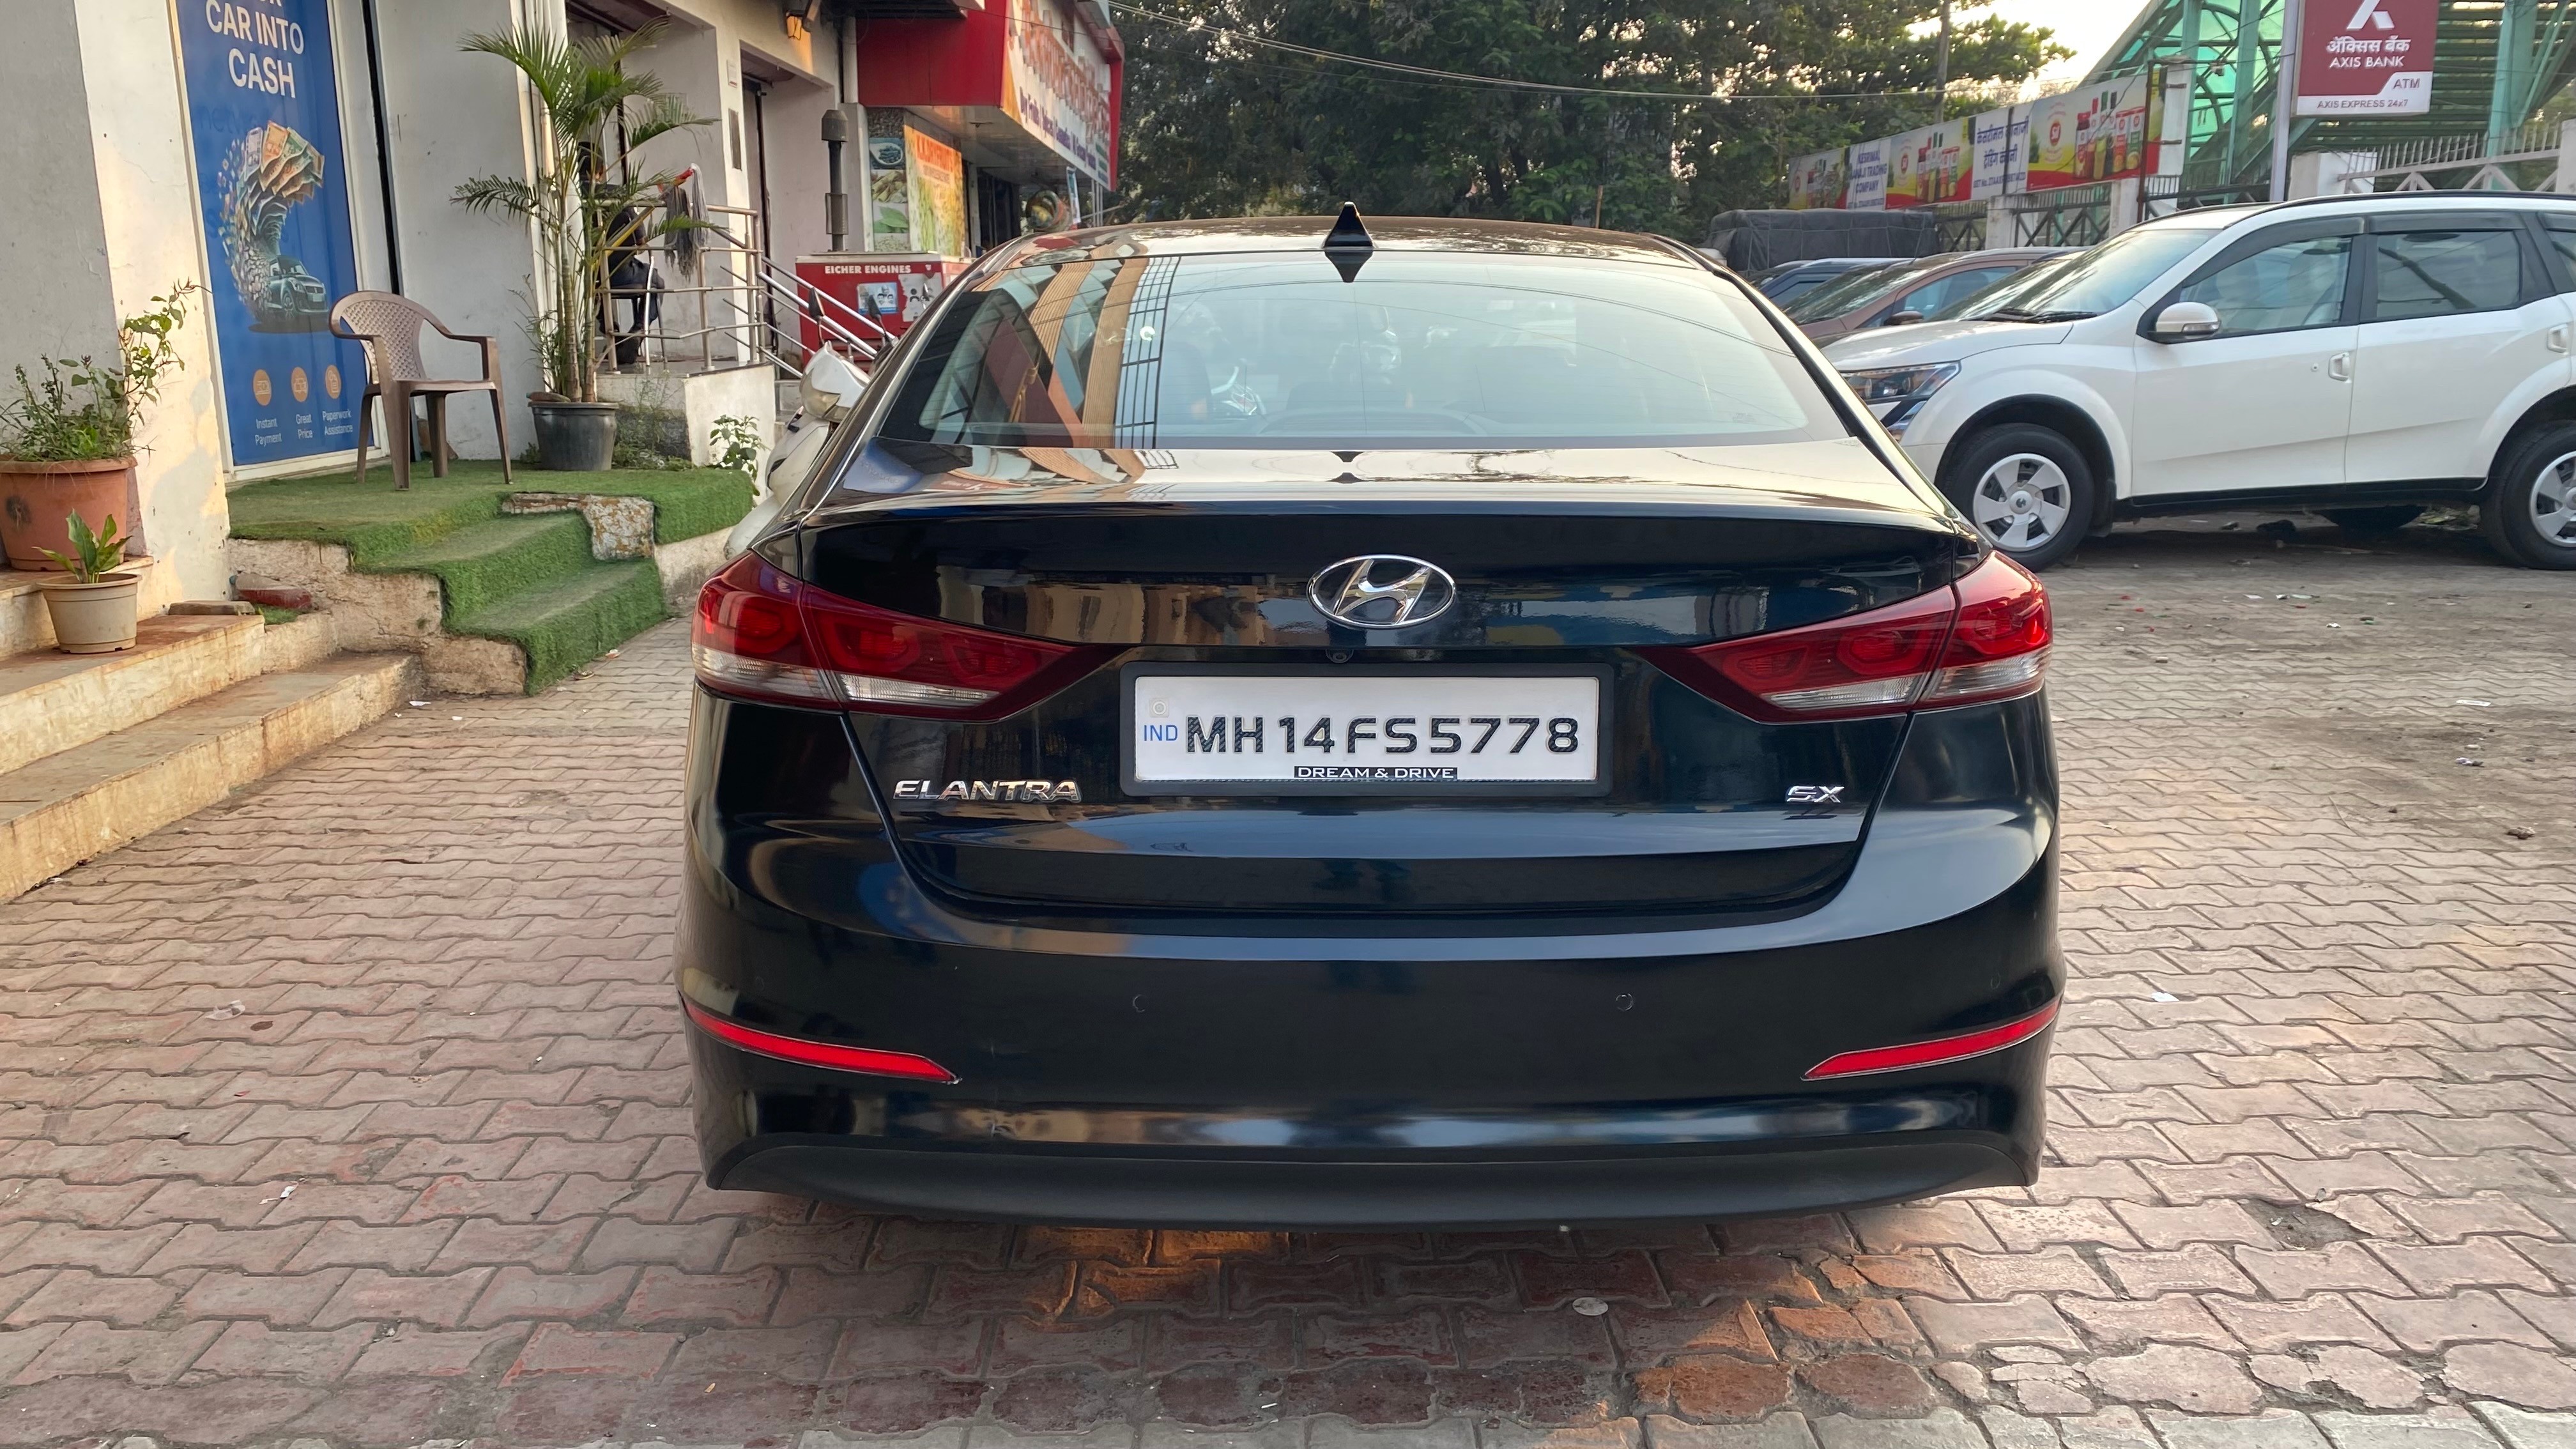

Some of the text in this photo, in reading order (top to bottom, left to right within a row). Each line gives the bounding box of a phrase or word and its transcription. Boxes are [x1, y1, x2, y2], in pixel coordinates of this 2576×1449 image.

[206, 0, 304, 54] CAR INTO
[2329, 56, 2405, 68] AXIS BANK
[229, 48, 296, 98] CASH
[2393, 79, 2420, 89] ATM
[2317, 99, 2408, 109] AXIS EXPRESS 24x7
[825, 264, 912, 274] EICHER ENGINES
[295, 414, 312, 424] Great
[322, 409, 351, 422] Paperwork
[256, 418, 277, 429] Instant
[297, 429, 313, 440] Price
[325, 424, 353, 435] Assistance
[254, 433, 282, 447] Payment
[1144, 724, 1178, 742] IND
[1298, 767, 1454, 778] DREAM & DRIVE
[894, 780, 1081, 801] ELANTRA
[1786, 785, 1844, 803] SX
